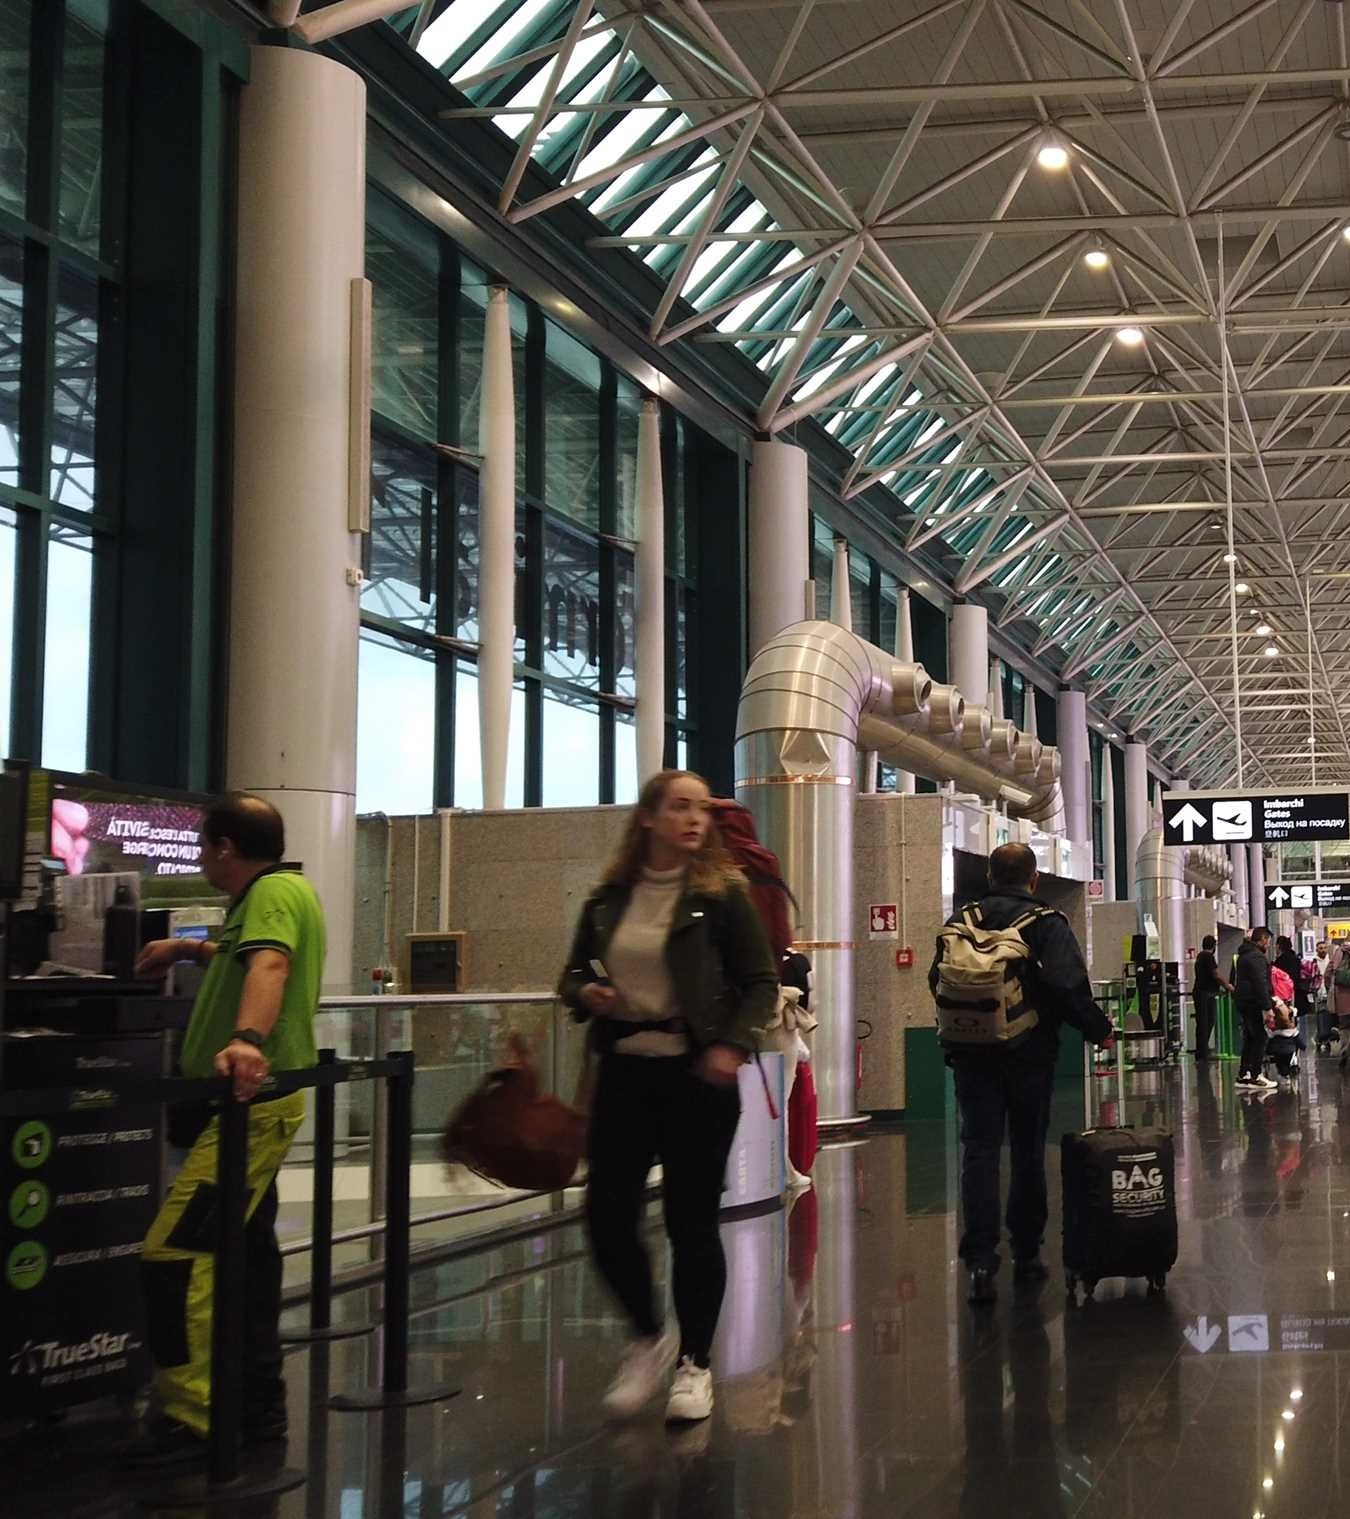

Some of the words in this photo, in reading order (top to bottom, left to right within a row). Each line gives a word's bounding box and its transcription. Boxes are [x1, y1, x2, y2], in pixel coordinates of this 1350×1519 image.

[1111, 1165, 1163, 1190] BAG
[1112, 1190, 1165, 1203] SECURITY
[40, 1331, 130, 1370] TrueStar
